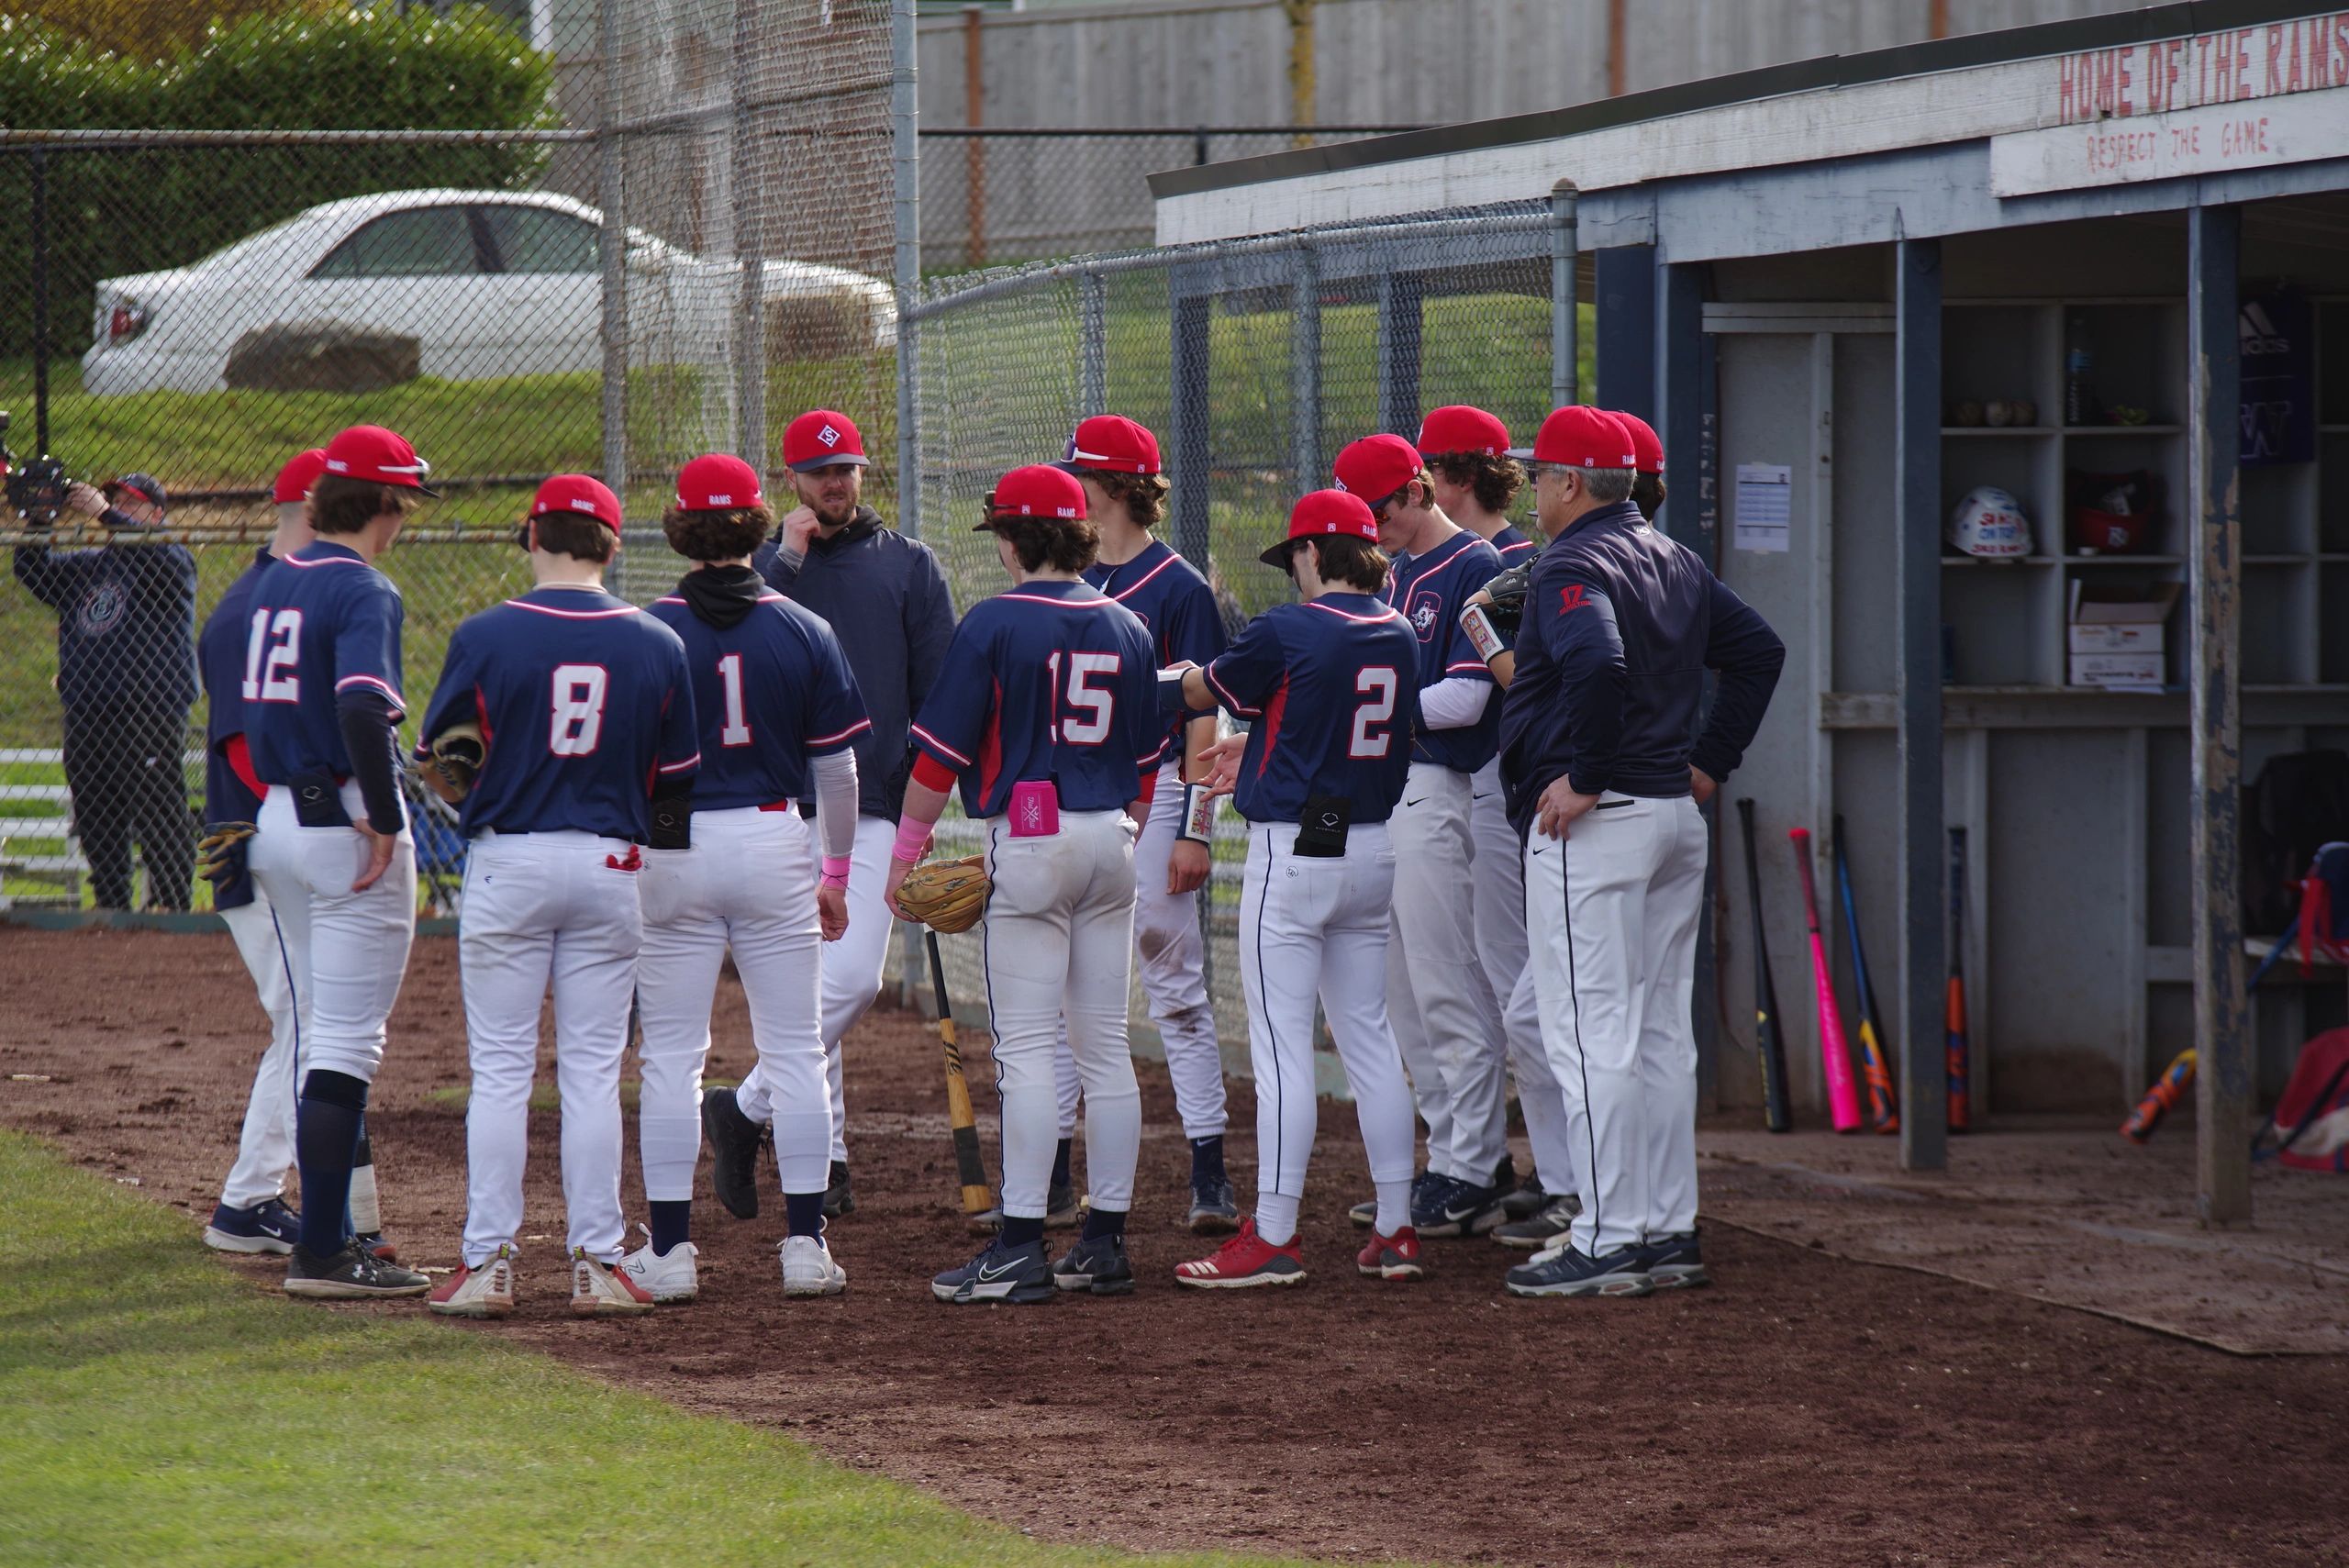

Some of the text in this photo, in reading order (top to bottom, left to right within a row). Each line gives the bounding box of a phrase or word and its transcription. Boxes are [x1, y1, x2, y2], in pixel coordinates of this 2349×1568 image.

[2060, 13, 2349, 125] HOME OF THE RAMS
[2087, 117, 2268, 173] RESPECT THE GAME
[571, 498, 596, 514] RAMS
[708, 495, 732, 506] RAMS
[1057, 507, 1075, 517] RAMS
[1560, 584, 1586, 605] 17
[242, 606, 302, 704] 12
[716, 652, 753, 748] 1
[1046, 650, 1120, 745] 15
[549, 662, 610, 758] 8
[1348, 665, 1398, 760] 2
